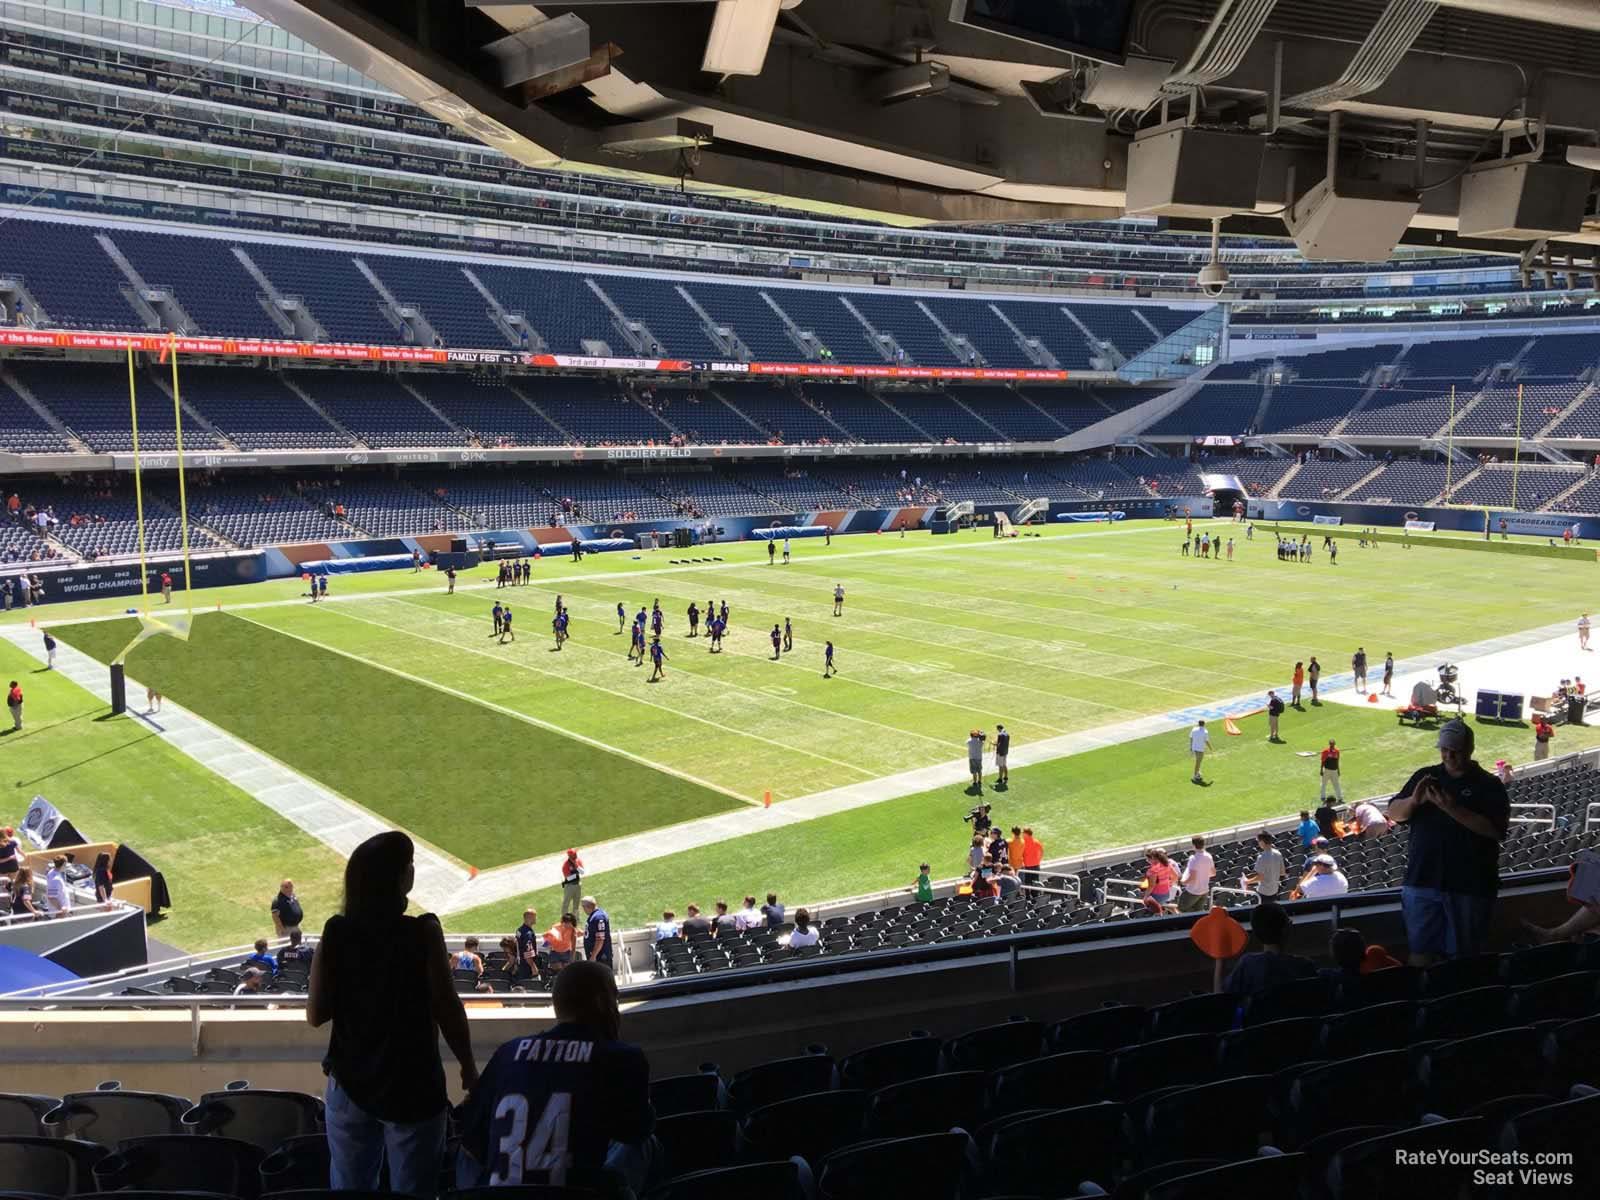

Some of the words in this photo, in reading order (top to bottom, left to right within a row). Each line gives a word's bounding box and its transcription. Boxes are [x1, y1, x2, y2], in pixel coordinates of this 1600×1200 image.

[8, 334, 25, 342] the
[26, 335, 54, 343] Bears
[100, 337, 115, 345] the
[116, 338, 141, 347] Bers
[183, 341, 197, 349] the
[198, 342, 222, 350] Bears
[447, 352, 478, 362] FAMILY
[480, 354, 501, 363] FEST
[711, 362, 749, 371] BEARS
[607, 449, 657, 459] SOLDIER
[660, 448, 692, 458] FIELD
[64, 582, 97, 593] WORLD
[513, 1038, 594, 1063] PAYTON
[489, 1092, 573, 1187] 34
